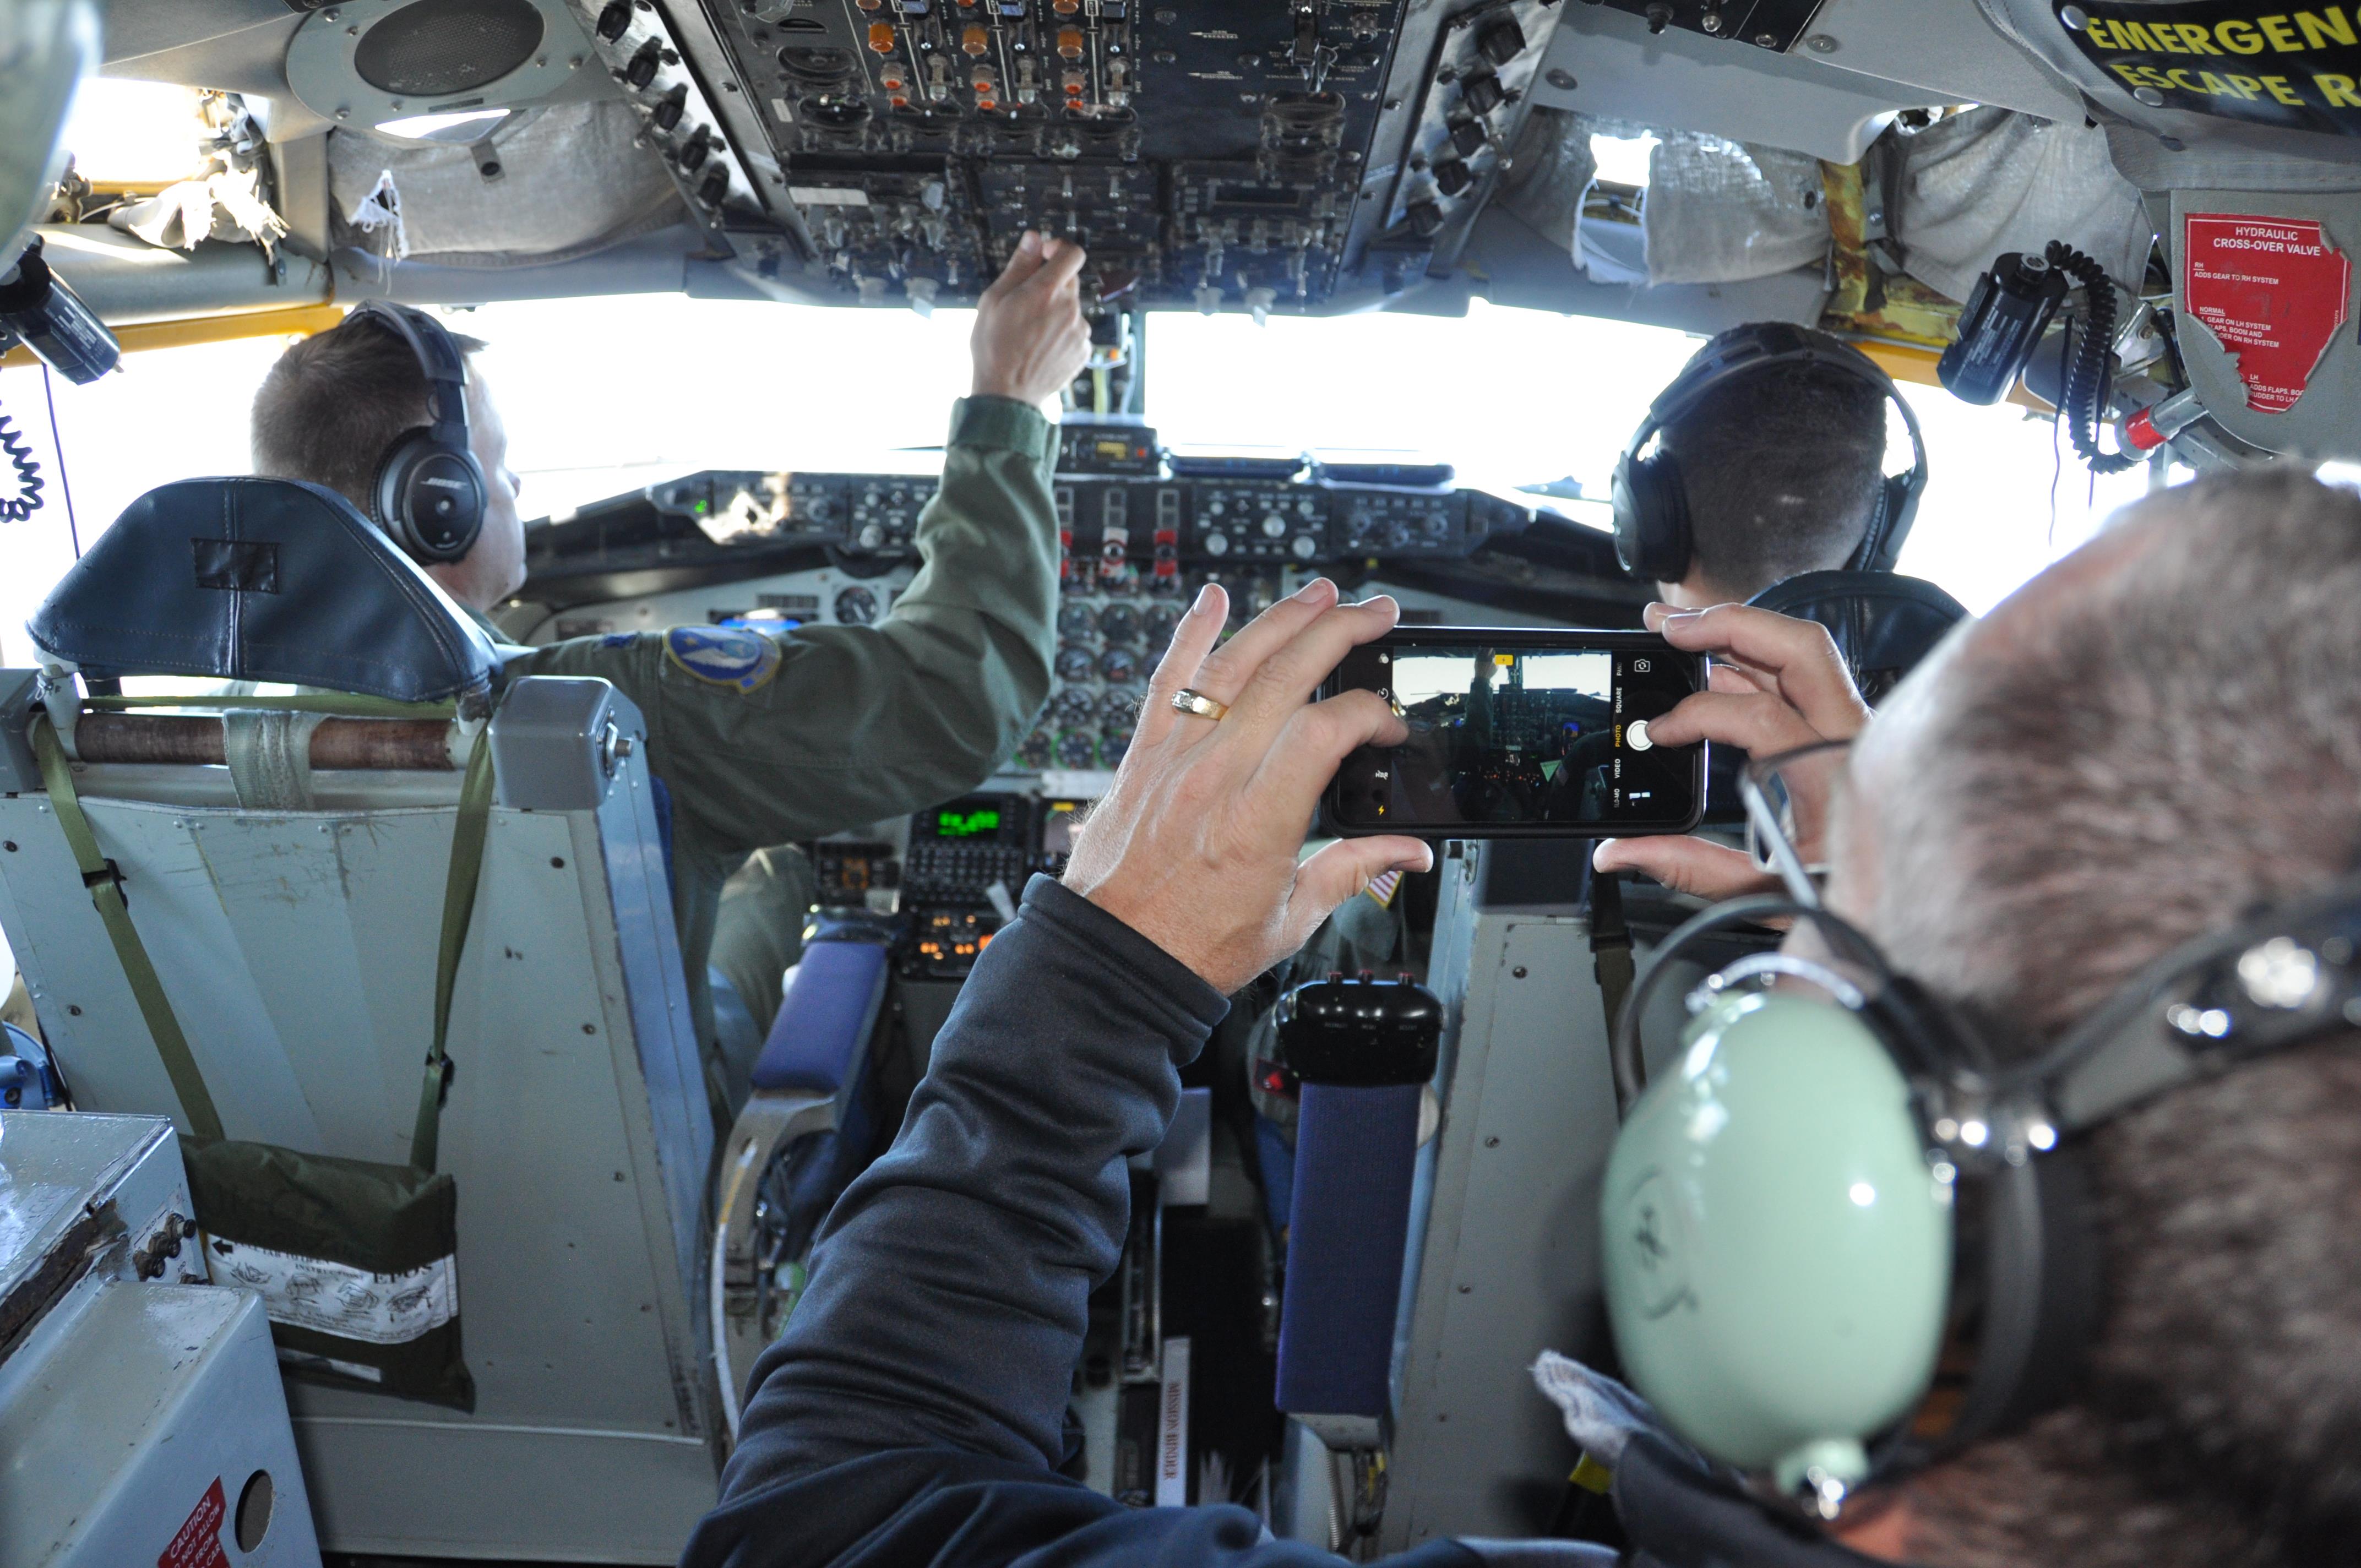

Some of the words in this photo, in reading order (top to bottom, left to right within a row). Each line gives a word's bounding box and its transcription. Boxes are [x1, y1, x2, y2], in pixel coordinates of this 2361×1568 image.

[2086, 5, 2361, 55] EMERGEN
[2109, 64, 2306, 106] ESCAPE
[2313, 73, 2361, 107] R
[2235, 227, 2298, 241] HYDRAULIC
[2213, 238, 2284, 253] CROSS-OVER
[2287, 244, 2321, 256] VALVE
[2253, 276, 2279, 285] SYSTEM
[2200, 306, 2225, 315] NORMAL
[2229, 326, 2248, 335] BOOM
[2249, 329, 2263, 338] AND
[2245, 322, 2271, 330] SYSTEM
[2254, 338, 2280, 348] SYSTEM
[2250, 383, 2266, 391] ADDS
[171, 1496, 211, 1559] CAUTION
[182, 1537, 197, 1563] NOT
[198, 1503, 220, 1540] ALLOW
[195, 1532, 214, 1564] FROM
[206, 1543, 221, 1566] CAR
